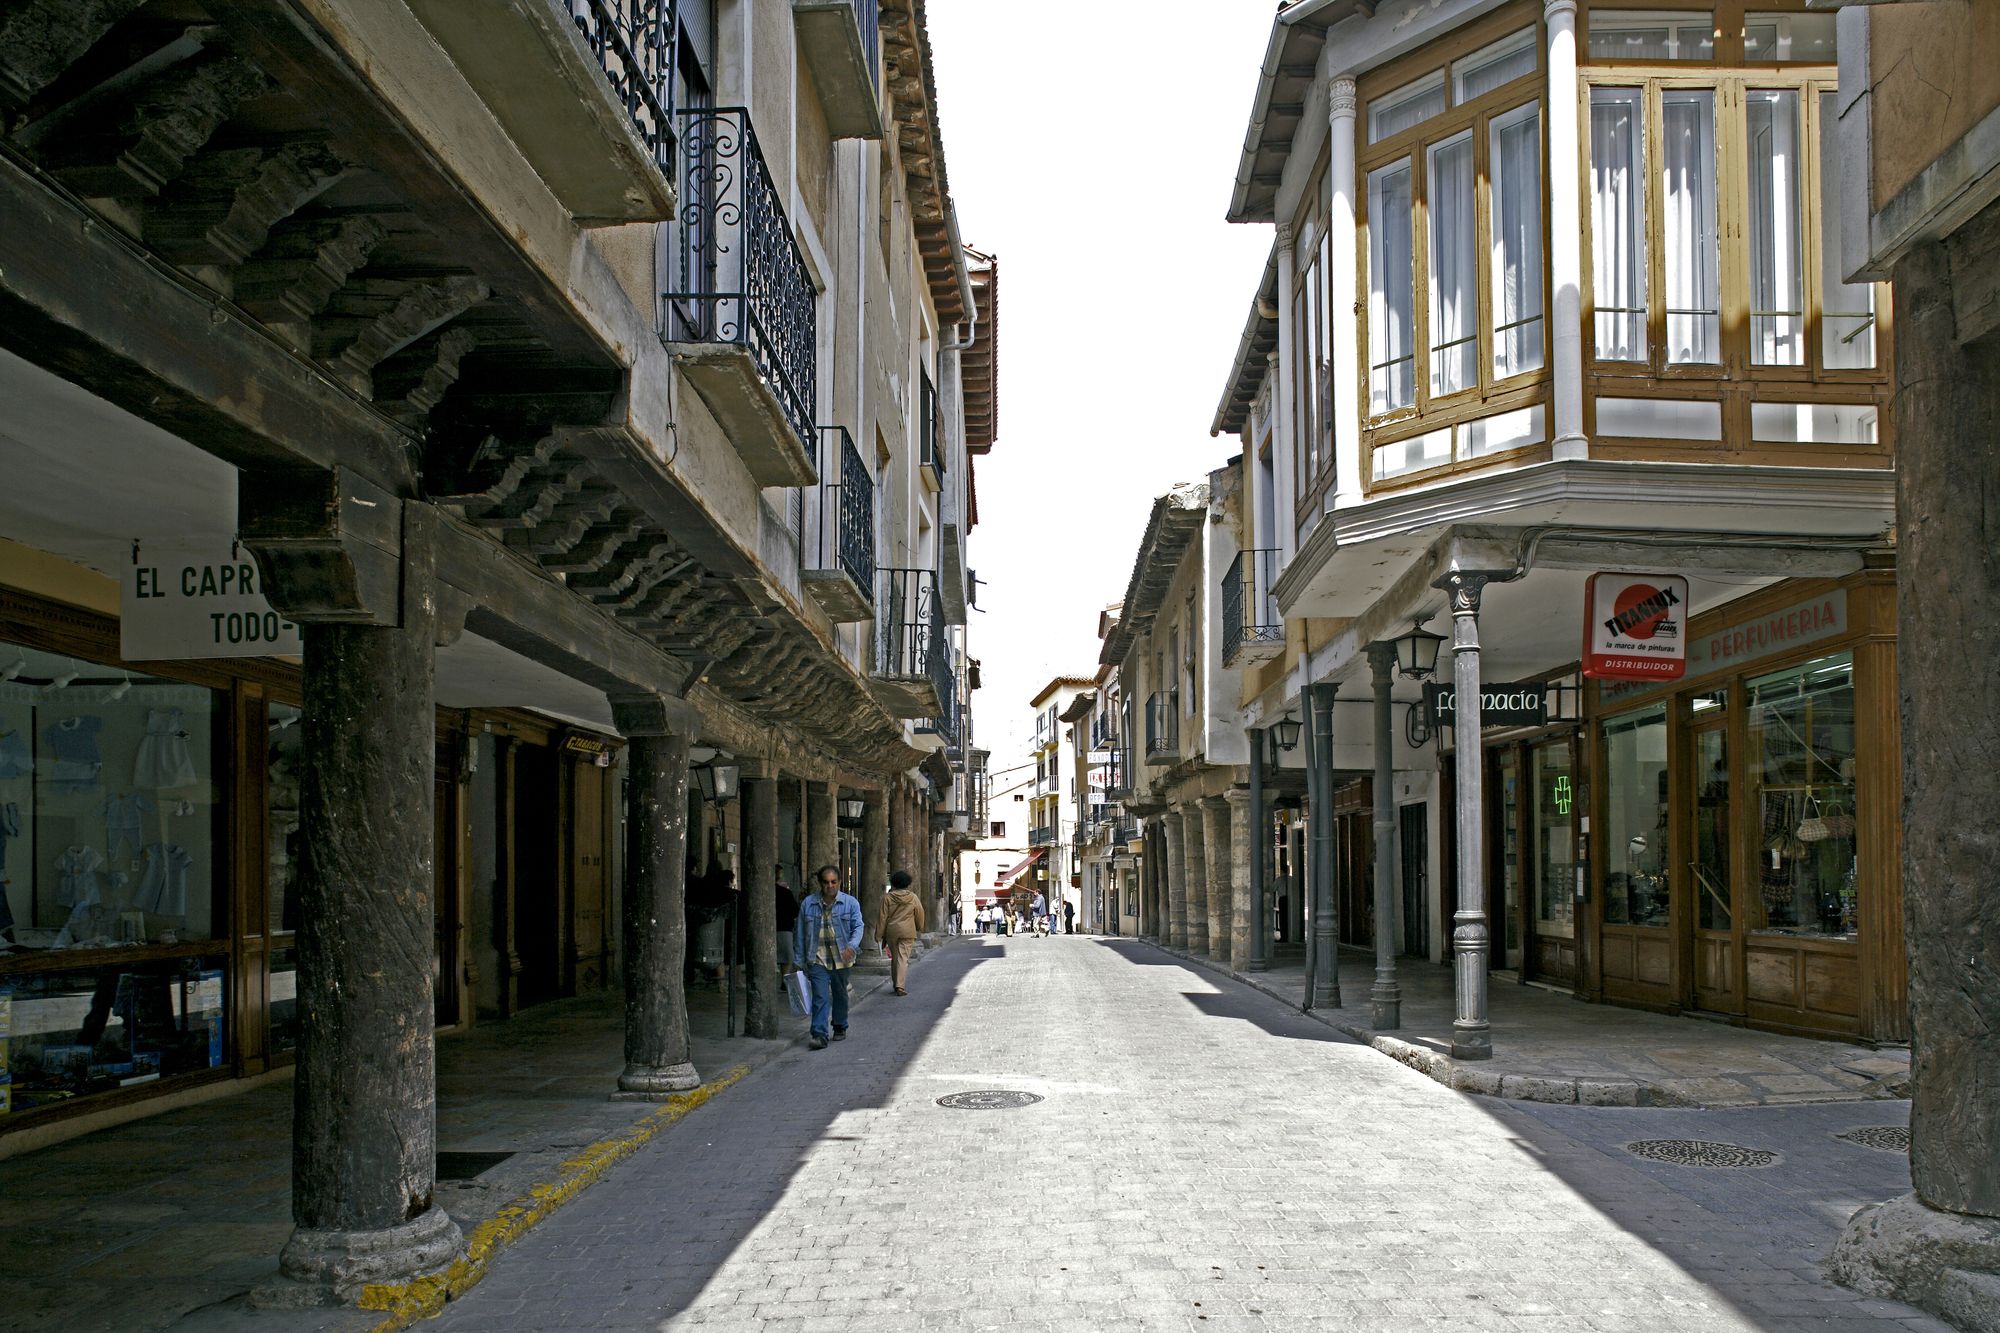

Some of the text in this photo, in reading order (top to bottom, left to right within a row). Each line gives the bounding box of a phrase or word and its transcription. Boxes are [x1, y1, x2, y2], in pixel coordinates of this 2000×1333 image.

[136, 564, 264, 598] EL CAPR
[1604, 586, 1680, 637] TITANLUX
[1711, 601, 1837, 661] PERFUMERIA
[1648, 644, 1675, 652] pinturas
[1605, 660, 1674, 671] DISTRIBUIDOR
[1436, 690, 1539, 717] famacía
